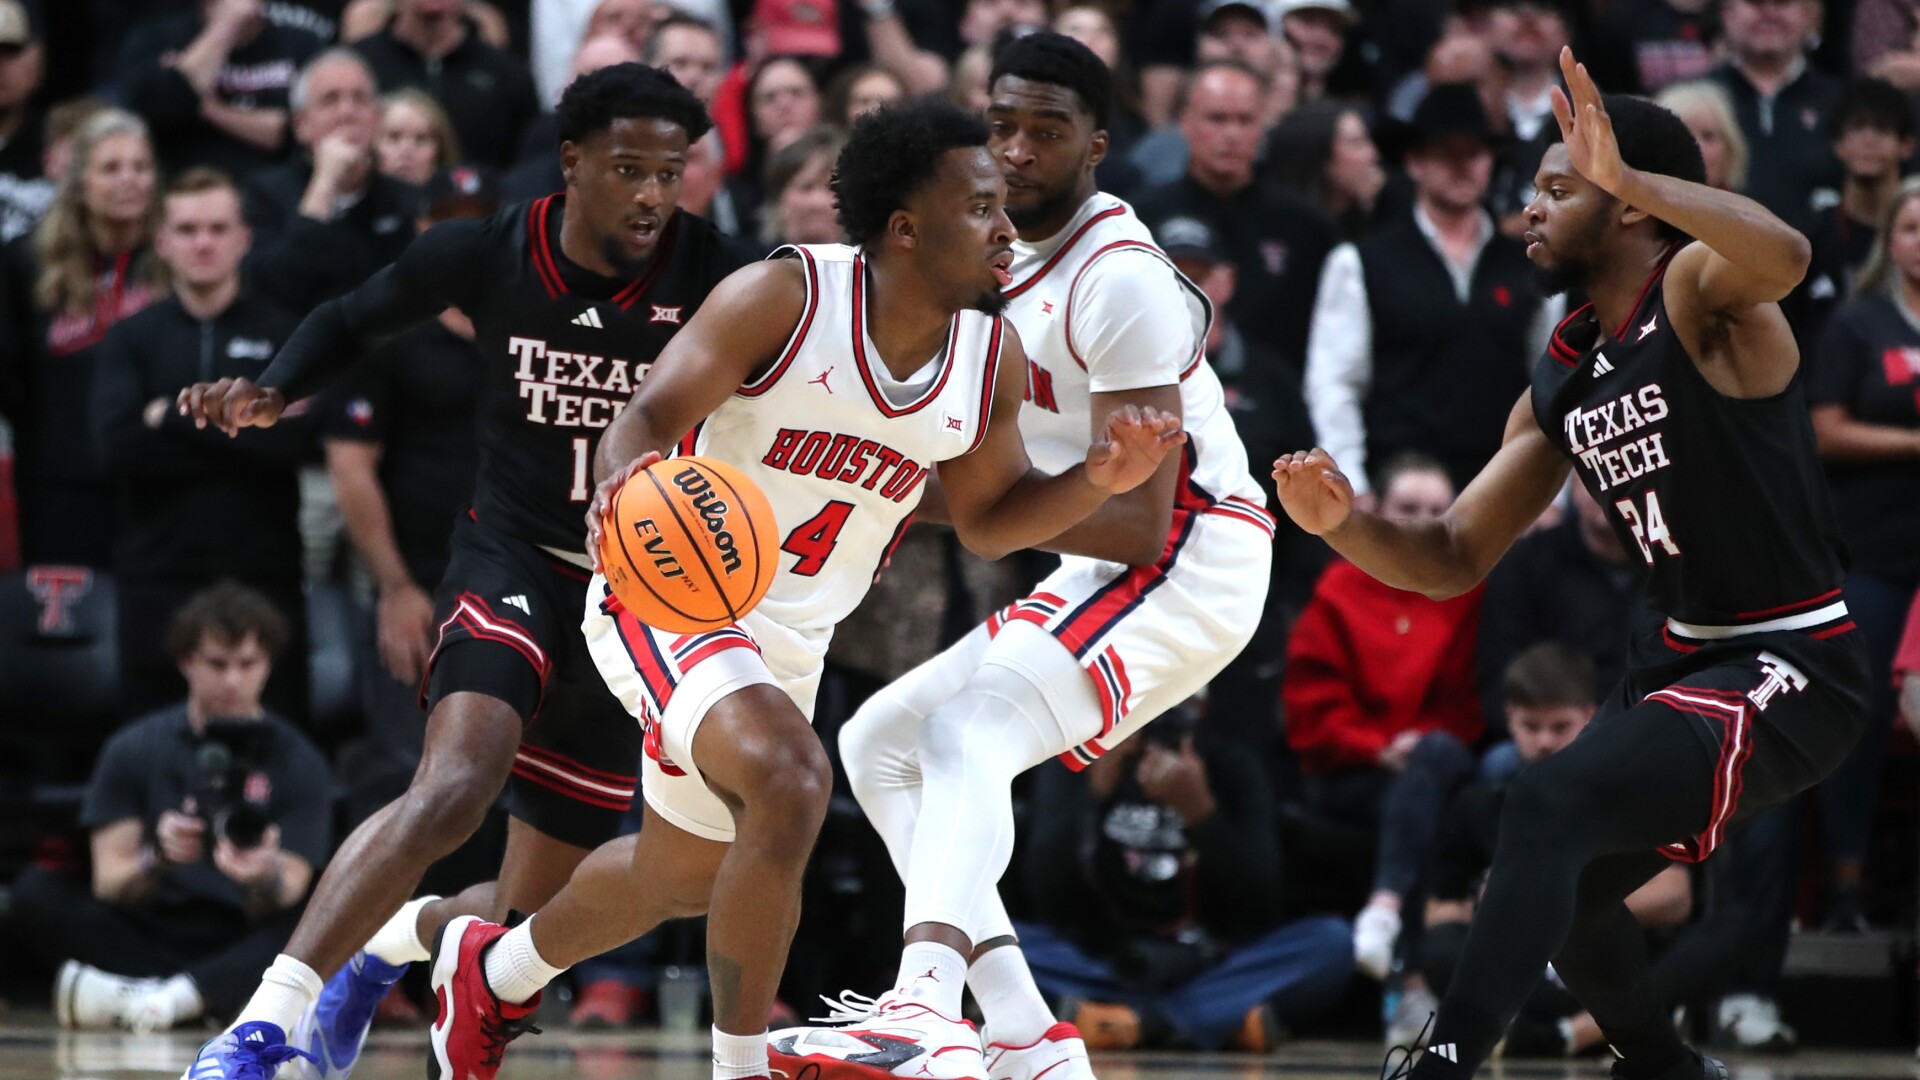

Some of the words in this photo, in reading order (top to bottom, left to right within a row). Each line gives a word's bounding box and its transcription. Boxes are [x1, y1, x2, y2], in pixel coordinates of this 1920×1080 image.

[1564, 383, 1669, 455] TEXAS
[1579, 432, 1671, 492] TECH
[672, 466, 743, 576] Wilson
[780, 499, 856, 577] 4
[1615, 489, 1681, 566] 24
[682, 575, 701, 594] NXT
